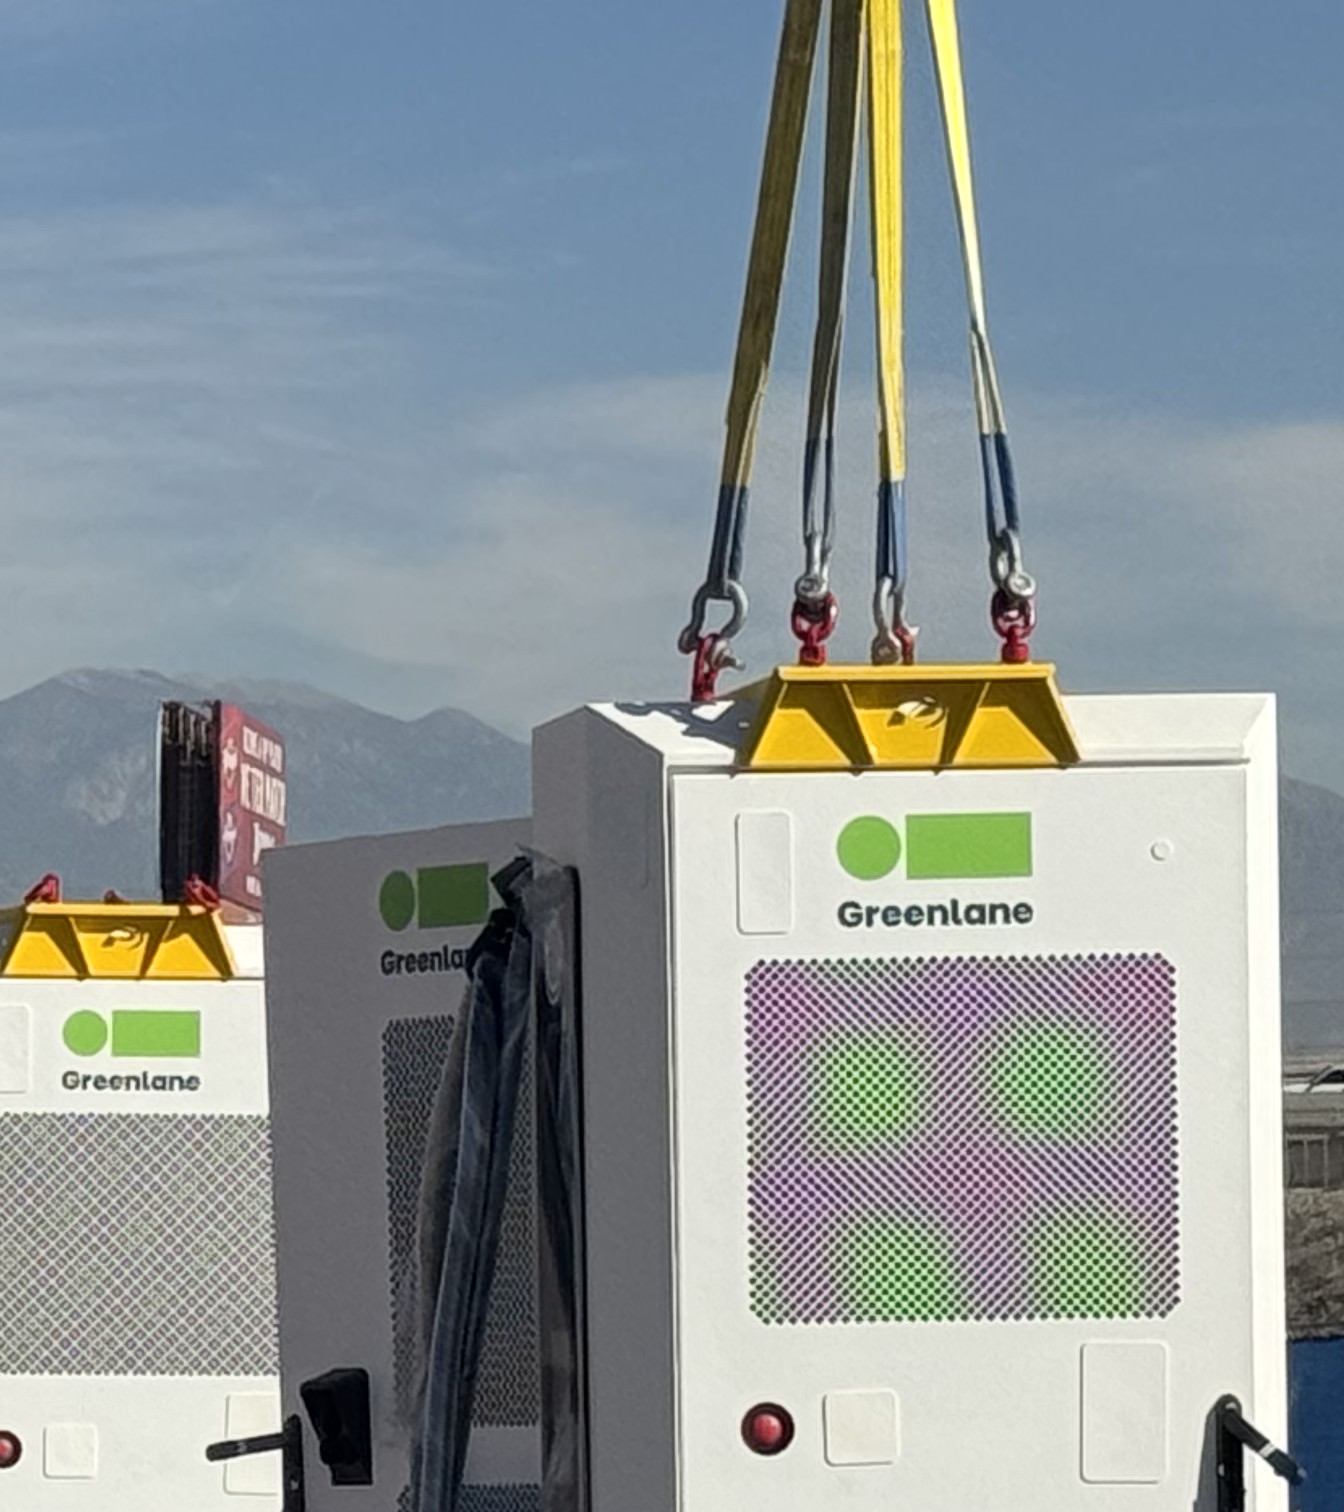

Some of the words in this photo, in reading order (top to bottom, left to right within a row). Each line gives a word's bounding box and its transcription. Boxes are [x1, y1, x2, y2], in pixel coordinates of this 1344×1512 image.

[837, 897, 1034, 928] Greenlane
[380, 944, 470, 976] Greenla
[61, 1070, 201, 1092] Greenlane
